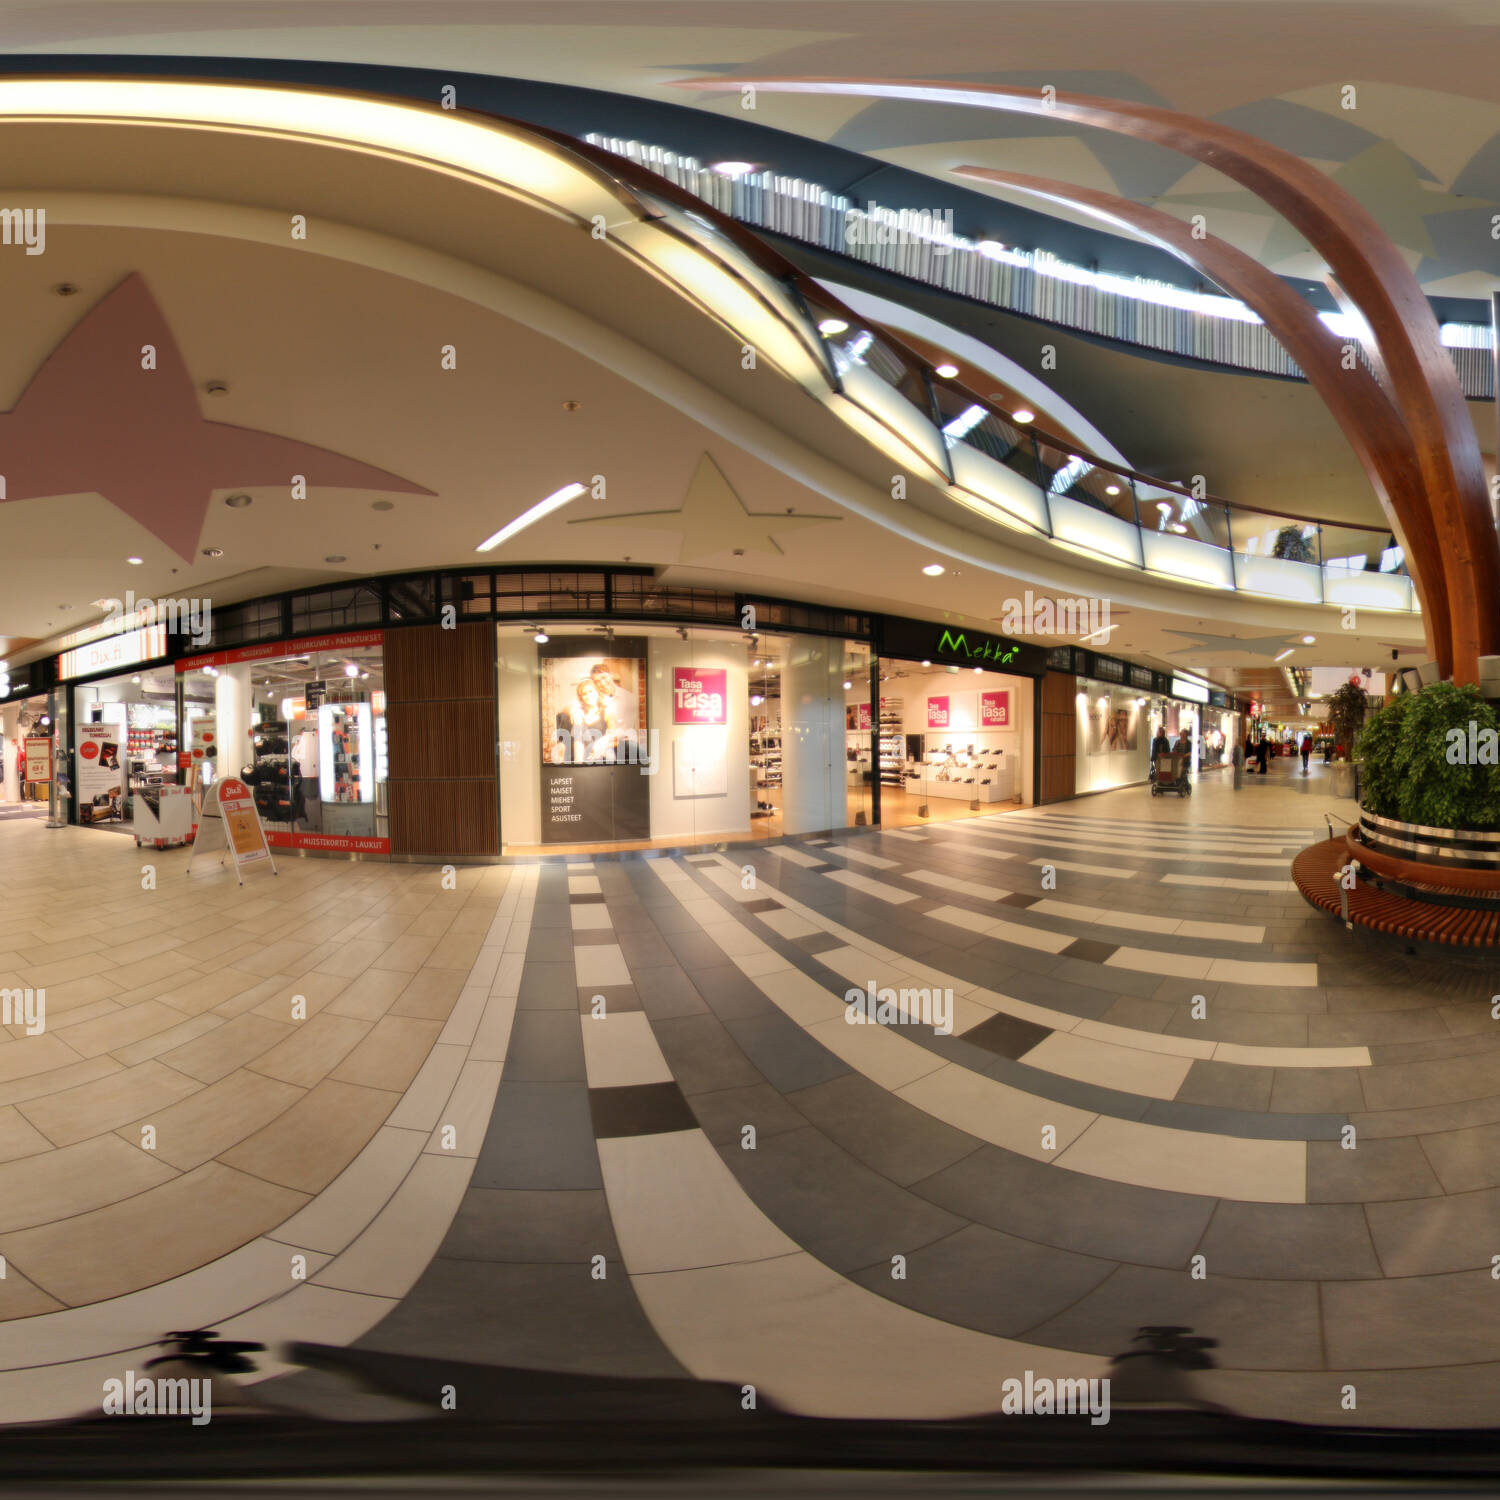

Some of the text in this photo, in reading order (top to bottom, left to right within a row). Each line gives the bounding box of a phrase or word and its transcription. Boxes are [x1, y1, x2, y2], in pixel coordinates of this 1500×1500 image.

[938, 630, 1019, 663] Mekka
[679, 678, 703, 689] Tasa
[674, 688, 723, 709] Tasa
[928, 709, 948, 720] Tasa
[981, 705, 1006, 717] Tasa
[551, 777, 572, 785] LAPSET
[551, 796, 574, 804] MIEHET
[303, 837, 349, 848] MUISTIKORTIT
[355, 840, 383, 849] LAUKUT
